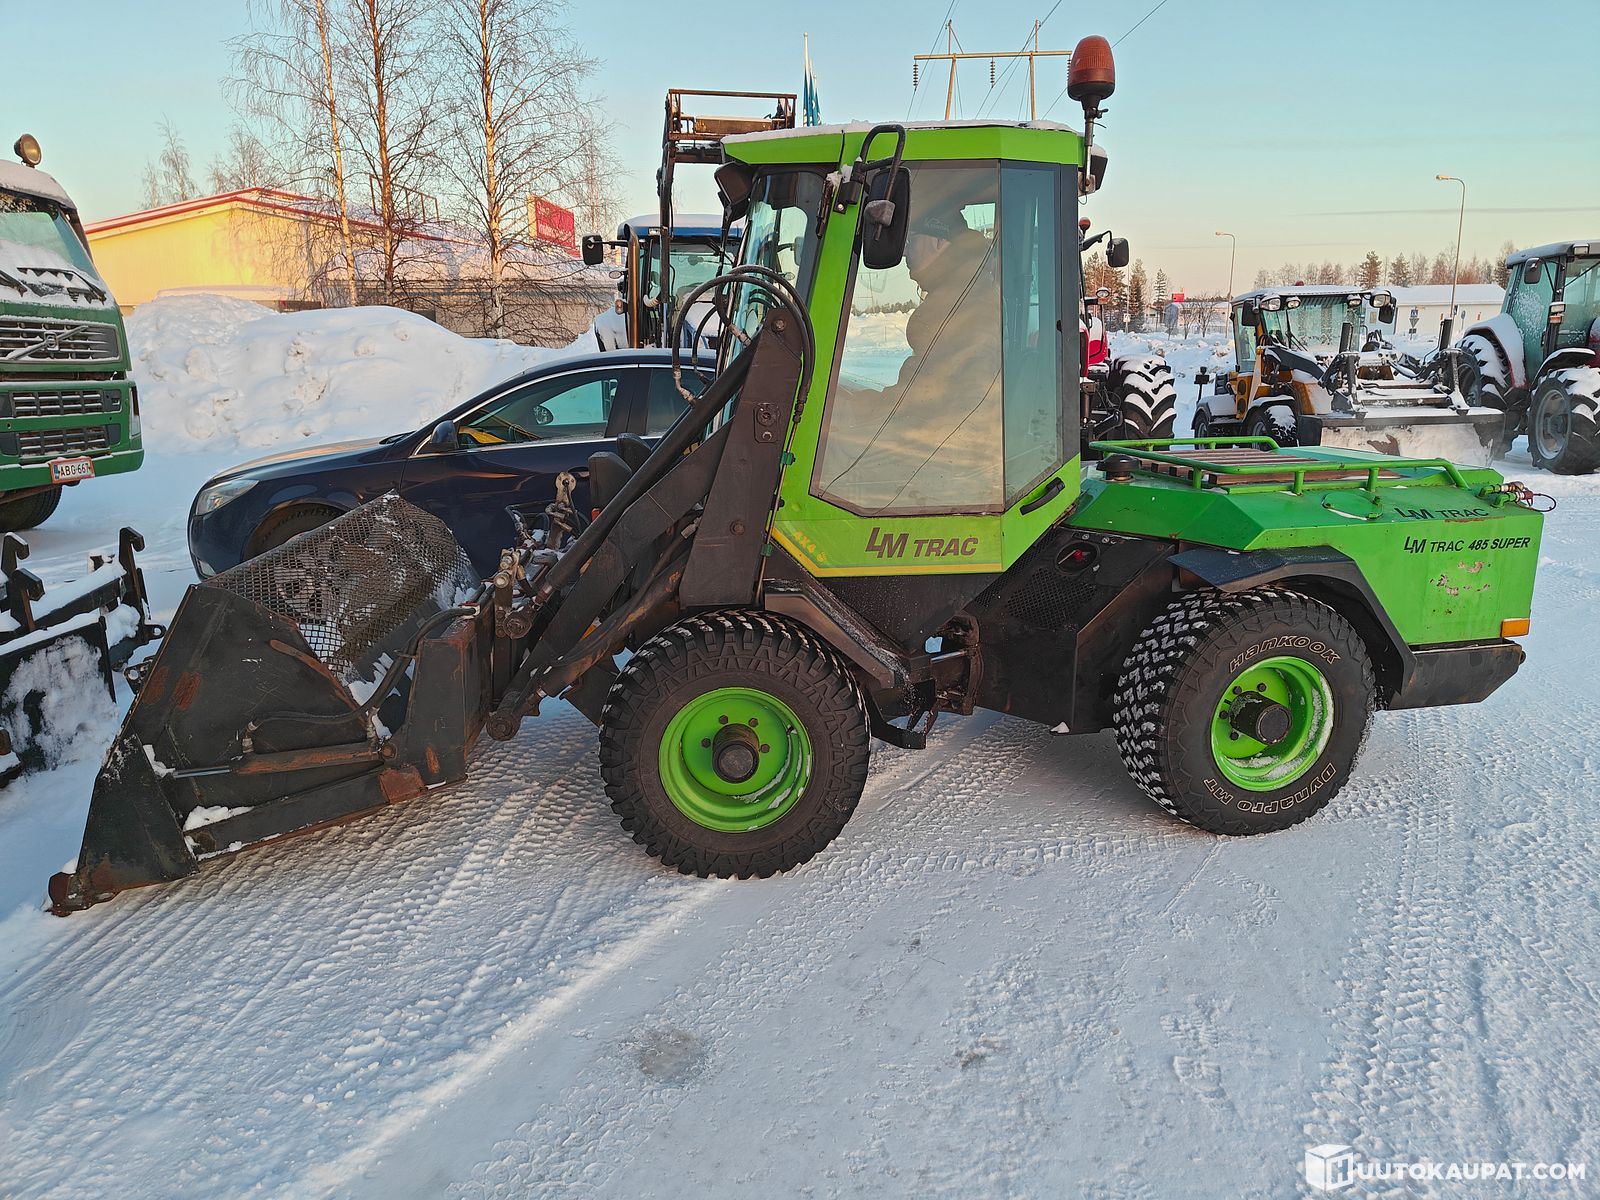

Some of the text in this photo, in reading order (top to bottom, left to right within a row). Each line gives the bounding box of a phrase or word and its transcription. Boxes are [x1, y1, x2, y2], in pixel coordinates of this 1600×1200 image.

[1394, 507, 1489, 520] LM TRAC
[865, 527, 979, 558] LM TRAC
[1403, 536, 1531, 553] LM TRAC 485 SUPER
[1203, 777, 1234, 805] MT
